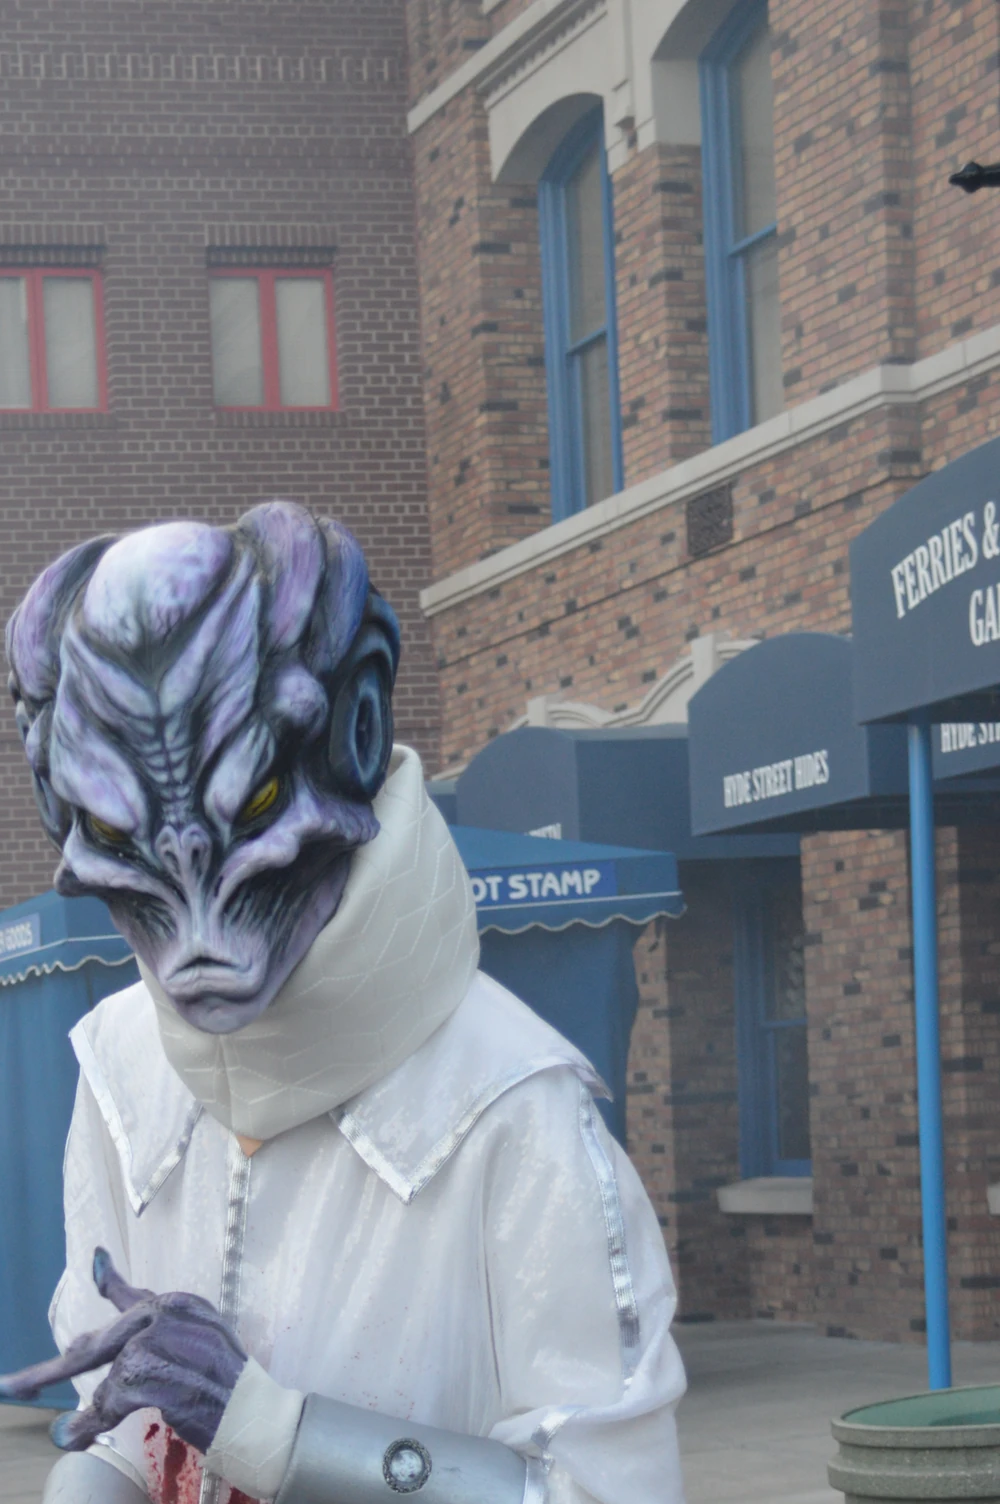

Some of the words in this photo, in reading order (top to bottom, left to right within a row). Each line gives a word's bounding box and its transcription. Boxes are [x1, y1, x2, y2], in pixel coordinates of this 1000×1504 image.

[891, 511, 979, 619] FERRIES
[982, 501, 1000, 560] &
[941, 722, 976, 753] HYDE
[723, 771, 752, 808] HYDE
[752, 759, 793, 801] STREET
[794, 749, 830, 790] HIDES
[508, 869, 601, 899] STAMP
